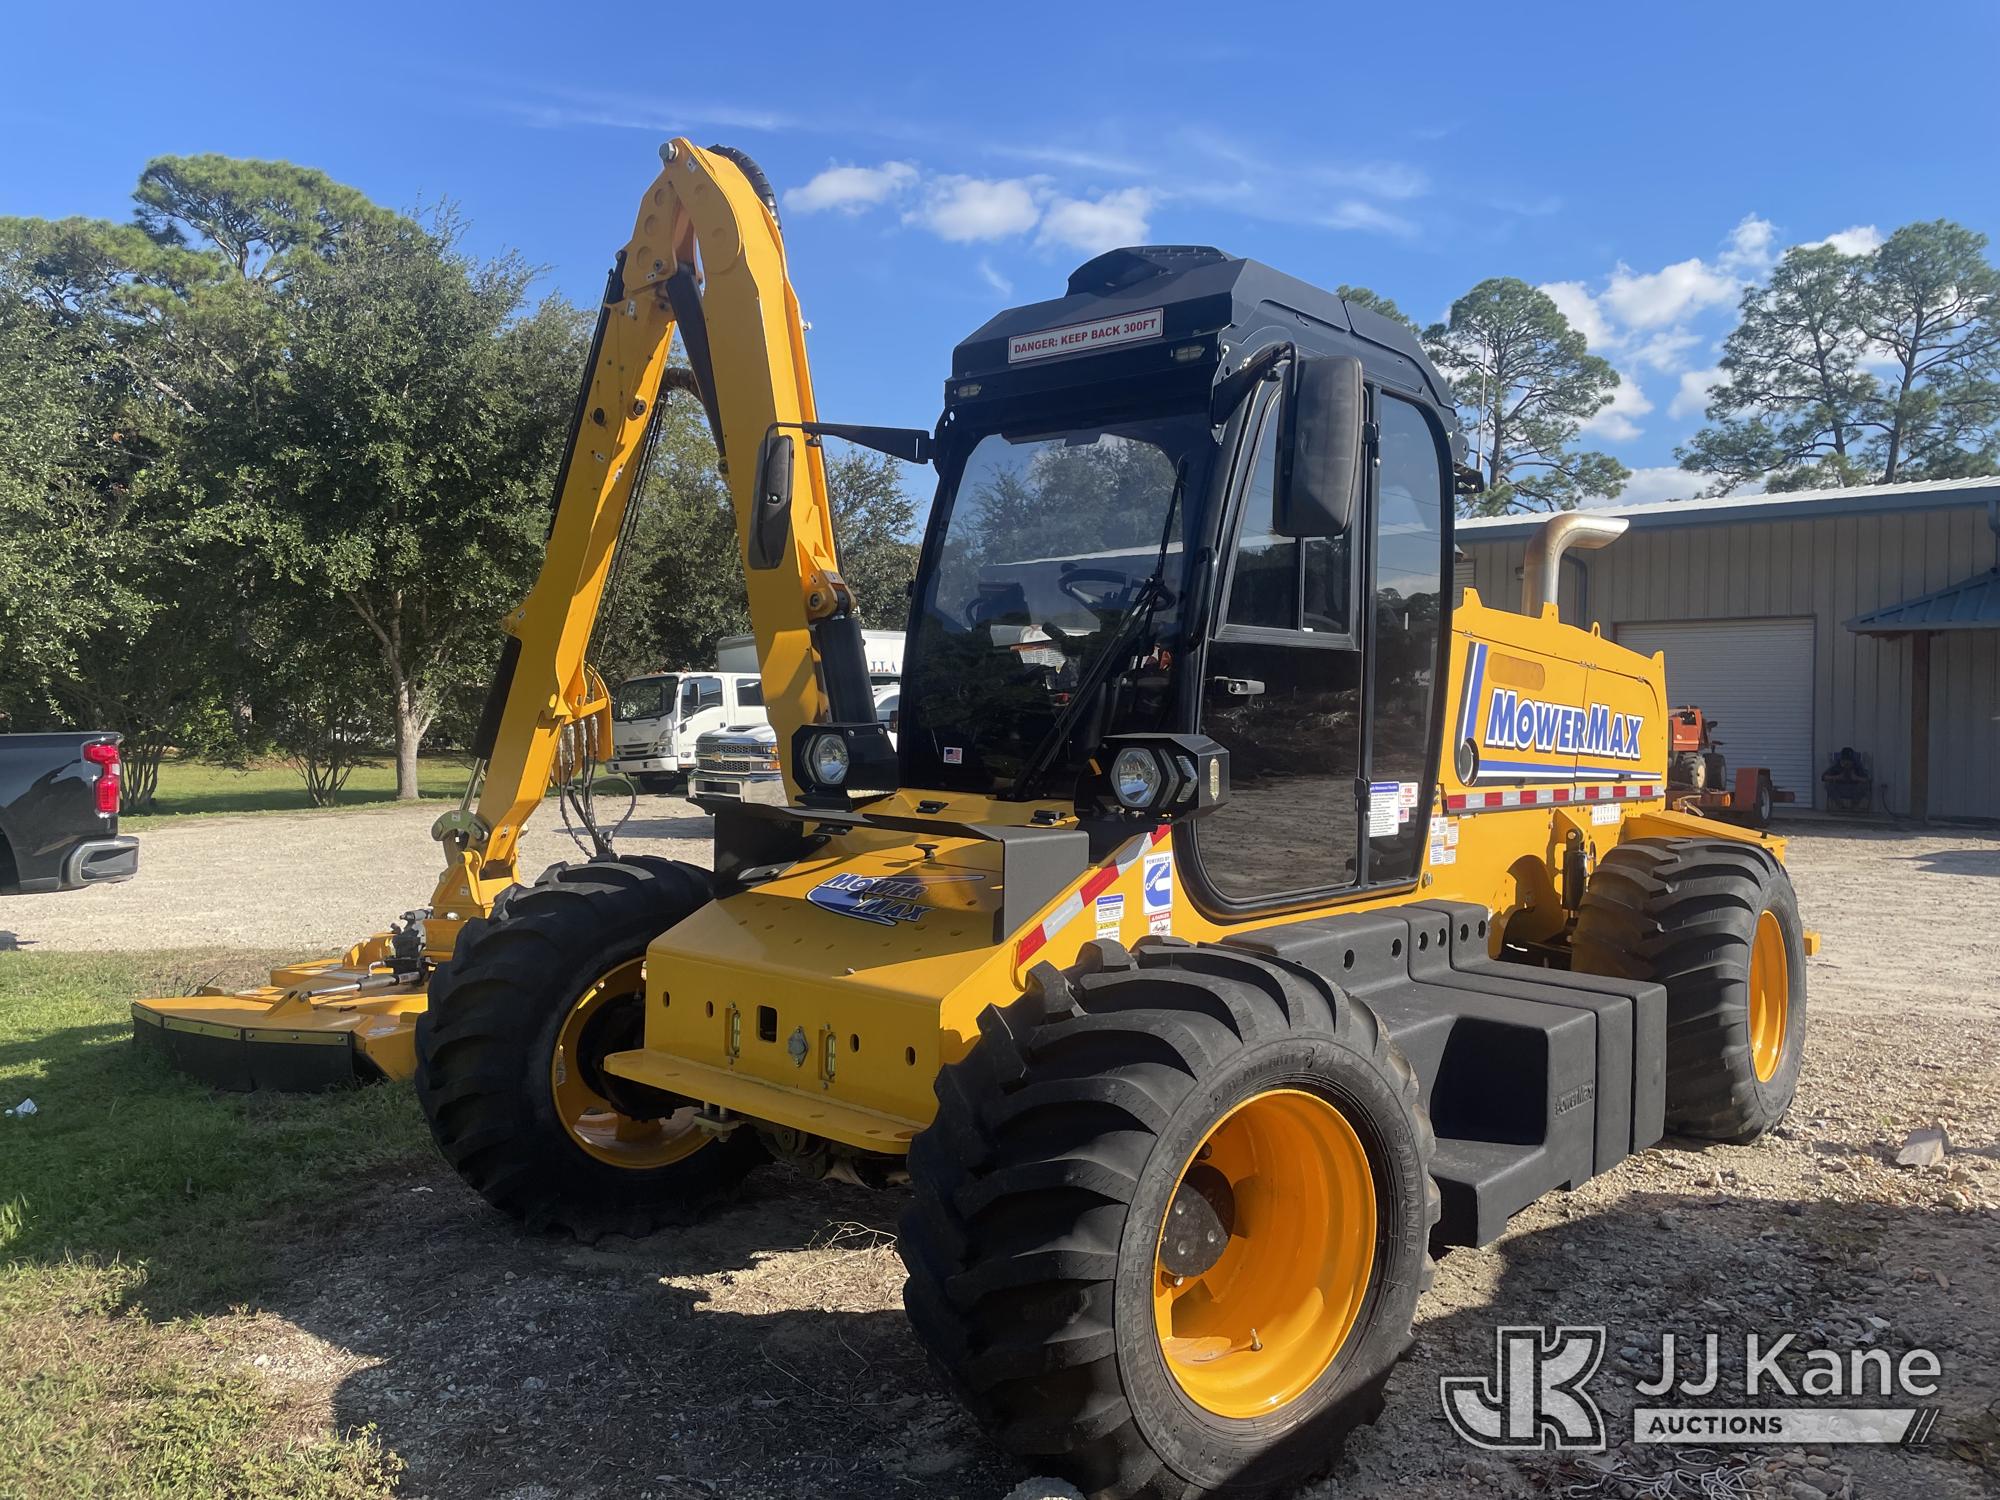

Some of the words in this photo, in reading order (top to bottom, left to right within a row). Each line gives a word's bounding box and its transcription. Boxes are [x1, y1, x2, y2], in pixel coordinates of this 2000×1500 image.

[1014, 337, 1058, 353] DANGER:
[1061, 332, 1088, 345] KEEP
[1091, 325, 1121, 339] BACK
[1123, 318, 1157, 334] 300FT
[1145, 862, 1169, 891] Cummins
[1399, 1144, 1419, 1257] ALLIANCE
